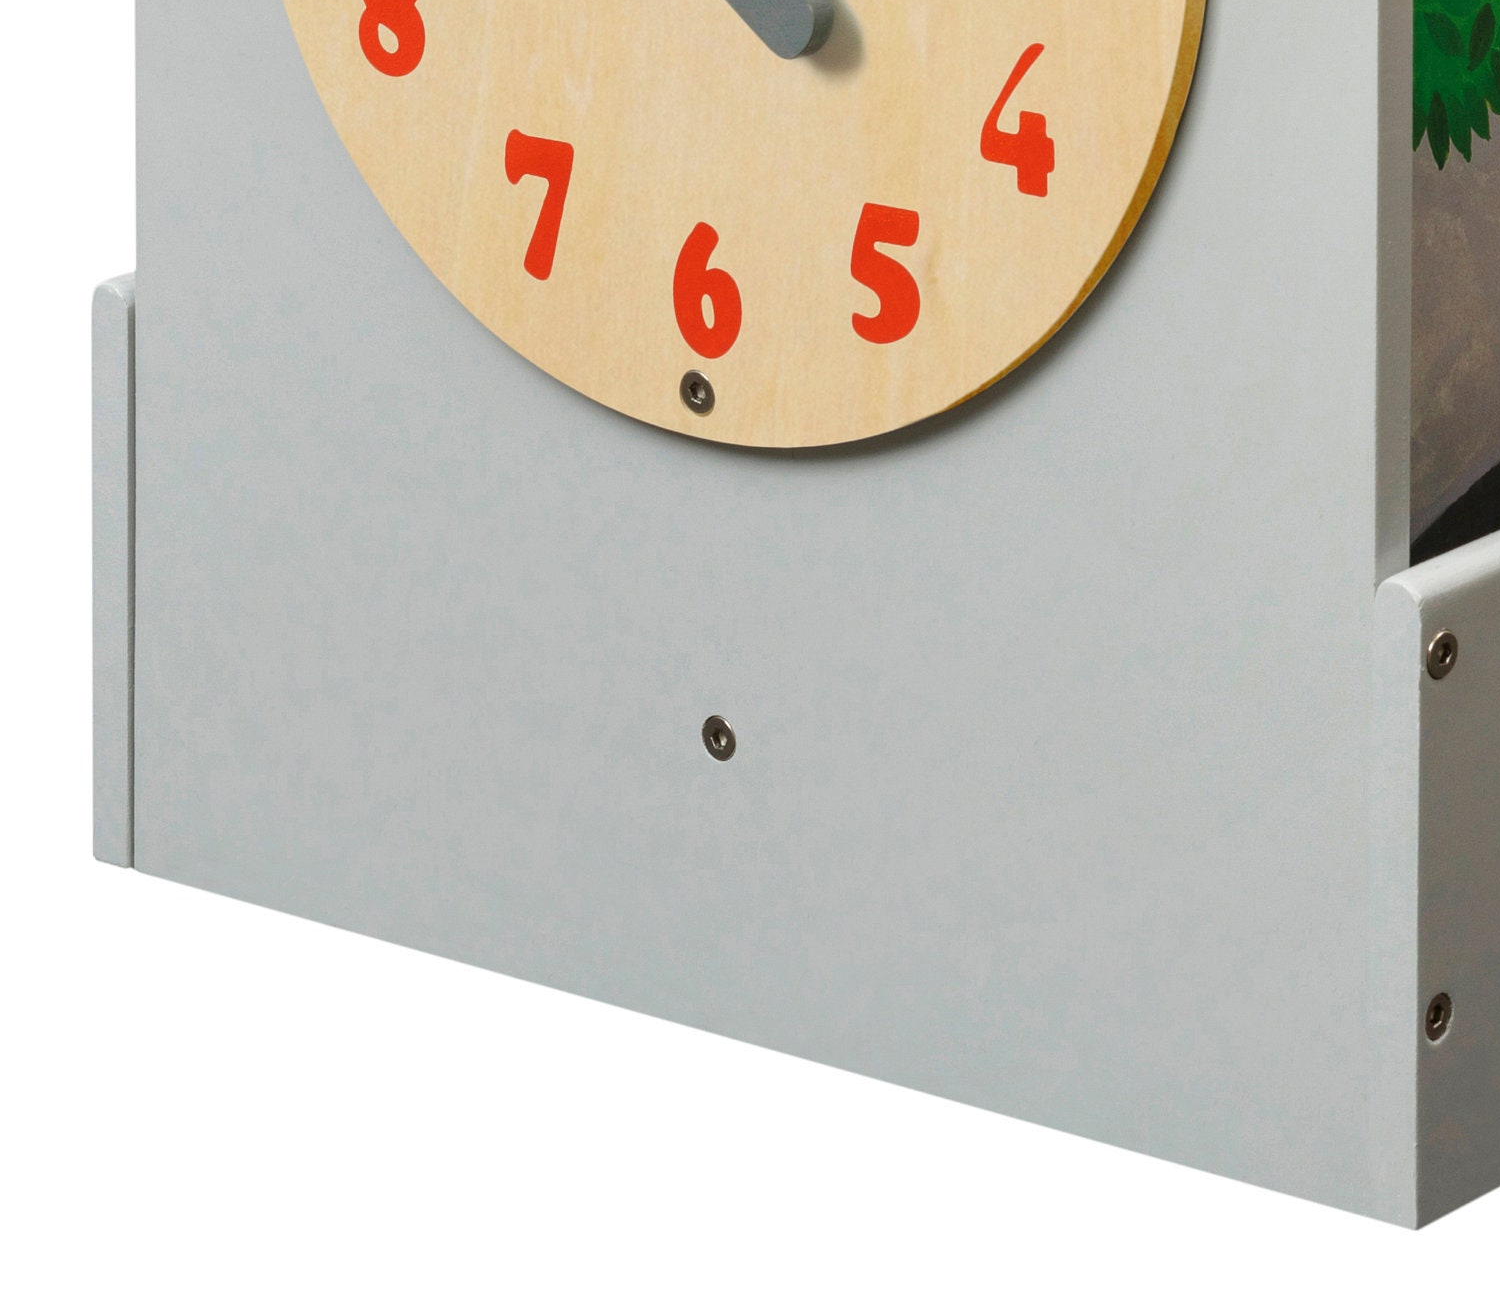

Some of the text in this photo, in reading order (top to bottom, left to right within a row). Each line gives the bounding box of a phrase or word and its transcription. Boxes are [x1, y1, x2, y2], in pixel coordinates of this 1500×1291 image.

[980, 43, 1055, 198] 4
[504, 129, 575, 281] 7
[850, 202, 921, 345] 5
[673, 222, 742, 359] 6
